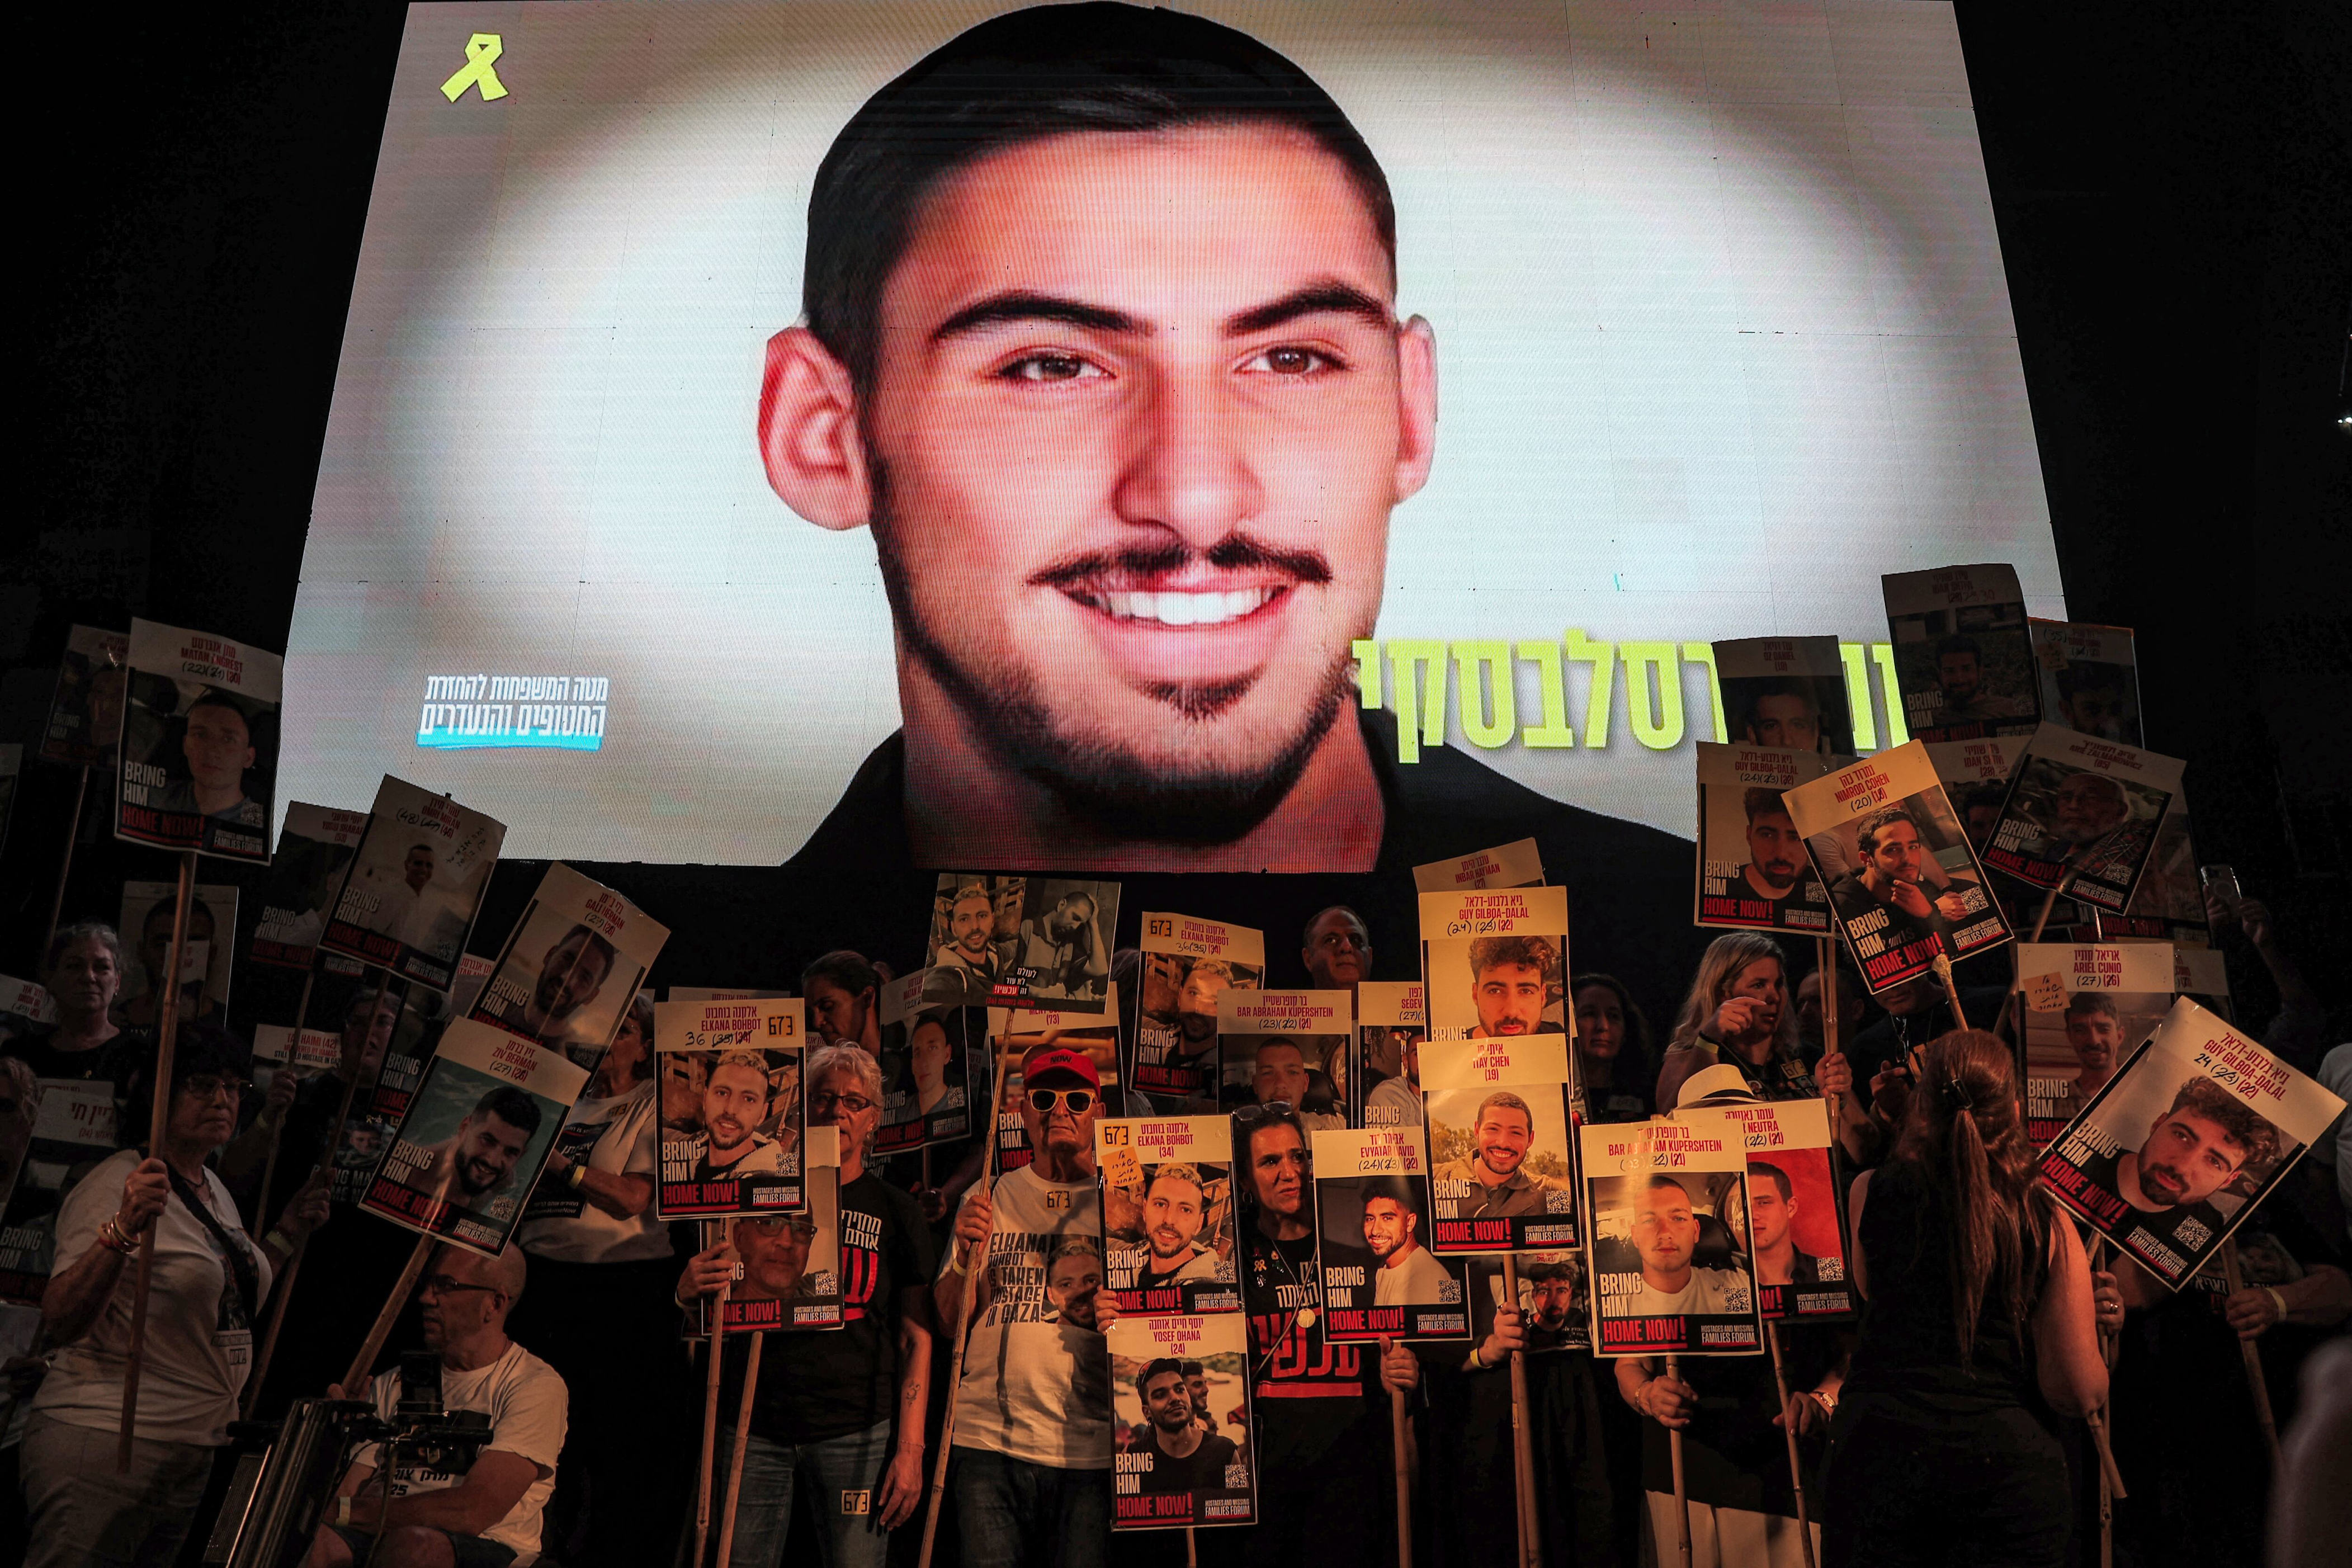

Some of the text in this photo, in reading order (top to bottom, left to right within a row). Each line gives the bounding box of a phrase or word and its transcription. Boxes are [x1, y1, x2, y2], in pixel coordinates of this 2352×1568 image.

[181, 648, 210, 663] MATAN
[425, 674, 608, 701] מטה המשפחות להחזרת
[1352, 629, 1728, 763] רסלבסקי
[420, 704, 606, 736] החטופים והנעדרים
[125, 760, 166, 788] BRING
[1735, 762, 1798, 774] GUY GILBOA-DALAL
[1839, 764, 1875, 788] נמרוד כהן
[124, 781, 148, 806] HIM
[1834, 773, 1890, 804] NIMROD COHEN
[1850, 795, 1872, 813] (20)
[122, 805, 158, 832] HOME
[1455, 863, 1501, 884] INBAR HAYMAN
[1474, 878, 1485, 890] (27)
[342, 886, 380, 913] BRING
[1465, 895, 1523, 907] גיא גלבוע-דלאל
[1703, 897, 1774, 919] HOME NOW!
[336, 902, 362, 925] HIM
[1459, 908, 1529, 920] GUY GILBOA-DALAL
[1846, 908, 1890, 939] BRING
[1151, 920, 1172, 937] 673
[1181, 931, 1229, 946] ELKANA BOHBOT
[1184, 921, 1225, 936] אלקנה בוחבוט
[1447, 920, 1471, 937] (24)
[1865, 949, 1907, 980] HOME
[2074, 949, 2119, 961] אריאל קוניו
[1017, 967, 1037, 978] לעולם
[2074, 962, 2122, 973] ARIEL CUNIO
[490, 976, 530, 1007] BRING
[994, 986, 1017, 994] עכשיו!
[2077, 976, 2101, 988] (27)
[480, 991, 509, 1018] HIM
[1300, 996, 1307, 1006] בר
[1401, 999, 1423, 1008] SEGEV
[705, 1006, 757, 1019] אלקנה בוחבוט
[1046, 1013, 1060, 1025] (73)
[1237, 1007, 1333, 1017] BAR ABRAHAM KUPERSHTEIN
[701, 1018, 761, 1031] ELKANA BOHBOT
[768, 1016, 793, 1035] 673
[301, 1034, 322, 1047] HAIMI
[492, 1047, 537, 1071] ZIV BERMAN
[1490, 1056, 1509, 1068] CHEN
[2194, 1053, 2212, 1068] 24
[2221, 1032, 2290, 1085] גיא גלבוע-דלאל
[1485, 1069, 1499, 1081] (19)
[2204, 1040, 2287, 1101] GUY GILBOA-DALAL
[2028, 1079, 2068, 1099] BRING
[1104, 1126, 1128, 1145] 673
[1141, 1122, 1189, 1135] אלקנה בוחבוט
[1749, 1121, 1779, 1133] NEUTRA
[1138, 1134, 1193, 1146] ELKANA BOHBOT
[1669, 1140, 1722, 1151] KUPERSHTEIN
[2074, 1119, 2122, 1159] BRING
[391, 1139, 434, 1170] BRING
[1159, 1146, 1174, 1158] (34)
[1361, 1147, 1392, 1158] EVYATAR
[381, 1158, 412, 1184] HIM
[663, 1161, 688, 1183] HIM
[371, 1179, 413, 1210] HOME
[663, 1179, 740, 1205] HOME NOW!
[753, 1193, 800, 1204] FAMILIES FORUM
[1433, 1178, 1472, 1199] BRING
[2042, 1153, 2129, 1224] HOME NOW!
[1047, 1191, 1070, 1208] 673
[1435, 1199, 1459, 1220] HIM
[841, 1209, 882, 1235] מחזירי
[1437, 1218, 1512, 1242] HOME NOW!
[844, 1228, 879, 1252] אותם
[989, 1232, 1047, 1253] ELKANA
[1526, 1231, 1574, 1242] FAMILIES FORUM
[2127, 1232, 2183, 1276] FAMILIES FORUM
[2134, 1225, 2188, 1269] HOSTAGES MISSING
[988, 1253, 1026, 1268] BOHBOT
[1001, 1267, 1044, 1286] TAKEN
[1108, 1269, 1131, 1289] HIM
[1326, 1265, 1365, 1287] BRING
[1602, 1272, 1643, 1295] BRING
[990, 1286, 1042, 1306] HOSTAGE
[1114, 1287, 1183, 1310] OME NOW!
[1327, 1288, 1352, 1308] HIM
[1000, 1303, 1040, 1324] GAZA
[1602, 1296, 1630, 1318] HIM
[1149, 1317, 1204, 1330] יוסף חיים אוחנה
[1329, 1306, 1405, 1331] HOME NOW!
[1418, 1320, 1465, 1330] FAMILIES FORUM
[1154, 1330, 1201, 1342] YOSEF OHANA
[1603, 1321, 1644, 1342] HOME
[1646, 1316, 1687, 1340] NOW!
[1702, 1332, 1755, 1343] FAMILIES FORUM
[1171, 1343, 1185, 1356] (24)
[1116, 1452, 1154, 1473] BRING
[389, 1484, 408, 1495] 25
[1116, 1473, 1141, 1494] HIM
[844, 1493, 868, 1512] 673
[1117, 1492, 1193, 1517] HOME NOW!
[1205, 1505, 1250, 1516] FAMILIES FORUM
